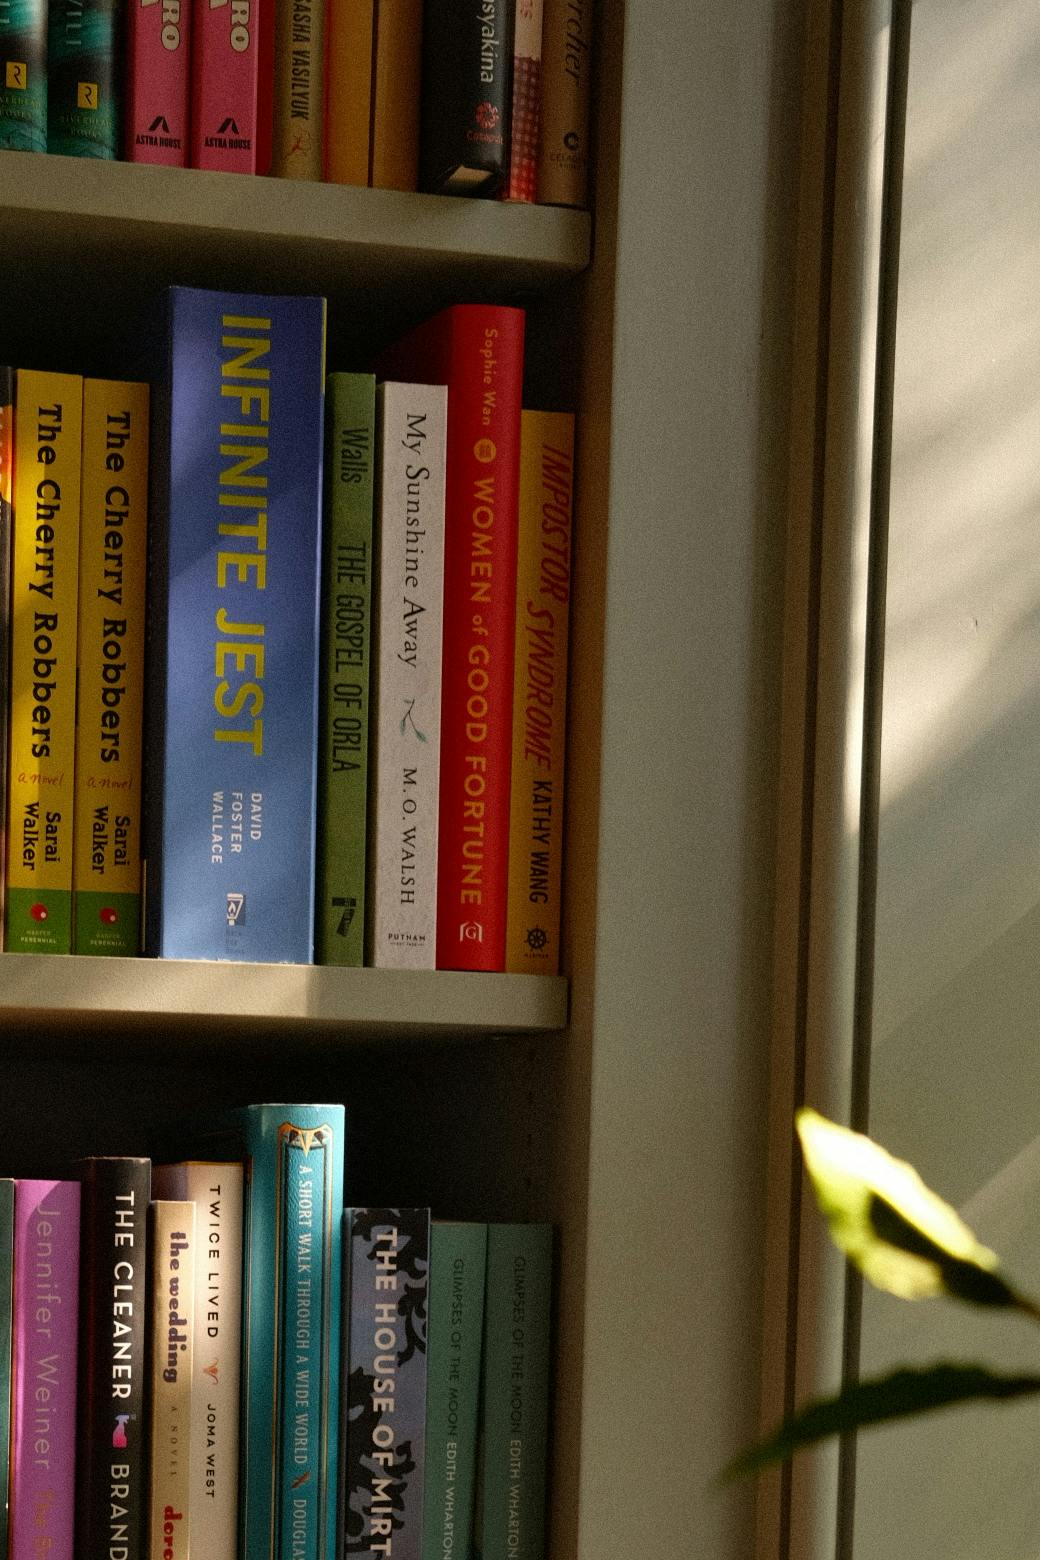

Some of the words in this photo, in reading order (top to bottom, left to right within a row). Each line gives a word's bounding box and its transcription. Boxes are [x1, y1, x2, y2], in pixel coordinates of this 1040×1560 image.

[291, 48, 309, 120] VASILYUK
[136, 136, 158, 147] ASTRA
[160, 138, 181, 150] HOUSE
[105, 411, 129, 471] The
[216, 313, 271, 589] INFINITE
[340, 428, 366, 483] Walls
[98, 485, 131, 603] Cherry
[338, 543, 366, 587] THE
[470, 478, 493, 602] WOMEN
[335, 594, 364, 672] GOSPEL
[471, 614, 488, 634] of
[99, 618, 127, 763] Robbers
[213, 607, 264, 755] JEST
[334, 682, 362, 709] OF
[466, 644, 489, 742] GOOD
[333, 717, 359, 771] ORLA
[89, 805, 110, 875] Walker
[112, 815, 131, 866] Sarai
[210, 791, 223, 863] WALLACE
[231, 792, 243, 853] FOSTER
[251, 793, 263, 840] DAVID
[461, 754, 486, 904] FORTUNE
[531, 779, 551, 844] KATHY
[529, 852, 549, 904] WANG
[299, 1164, 313, 1175] A
[113, 1191, 134, 1247] THE
[208, 1185, 221, 1258] TWICE
[298, 1180, 313, 1226] SHORT
[298, 1233, 312, 1272] WALK
[373, 1228, 398, 1290] THE
[112, 1261, 133, 1398] CLEANER
[207, 1273, 220, 1338] LIVED
[296, 1279, 312, 1350] THROUGH
[295, 1355, 310, 1364] A
[372, 1302, 398, 1412] HOUSE
[295, 1369, 310, 1407] WIDE
[293, 1413, 309, 1464] WORLD
[371, 1425, 395, 1467] OF
